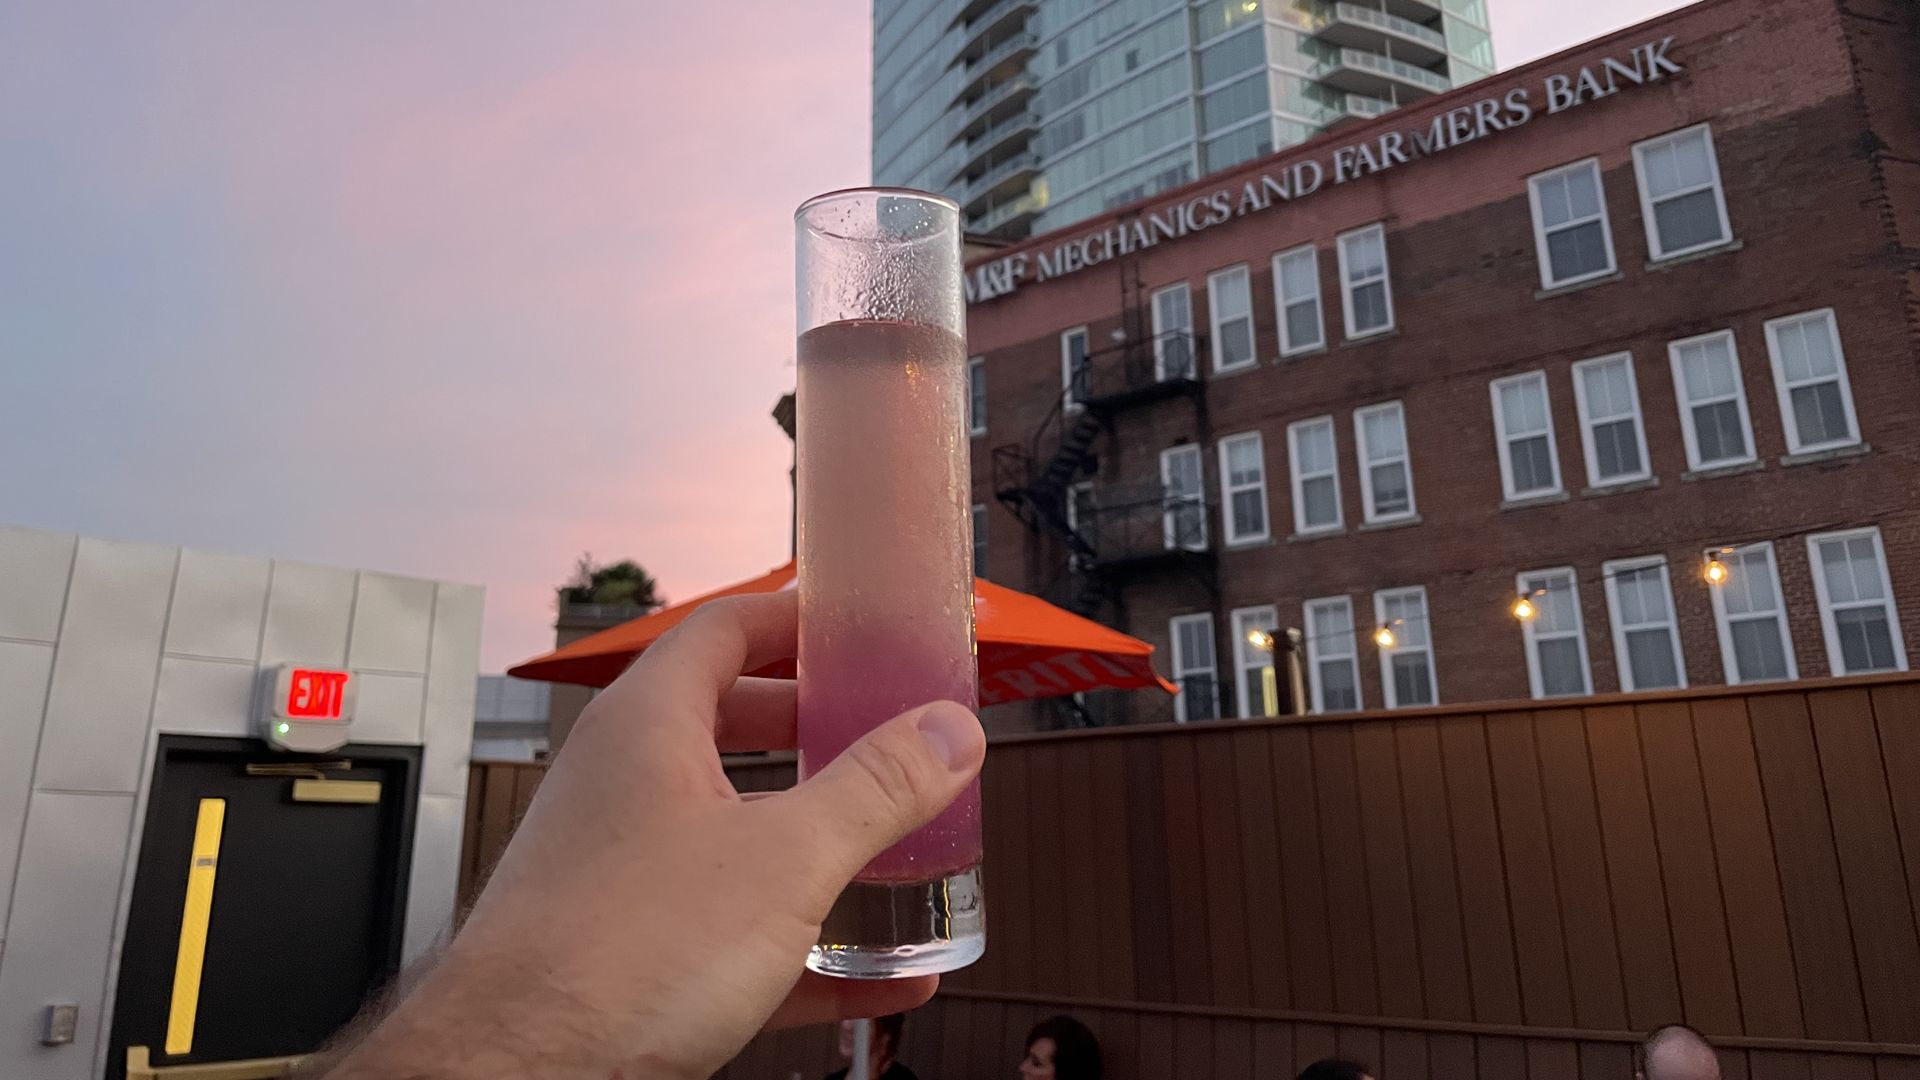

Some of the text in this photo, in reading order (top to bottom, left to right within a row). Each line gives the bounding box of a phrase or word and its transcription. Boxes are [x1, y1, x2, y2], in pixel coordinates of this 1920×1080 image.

[964, 34, 1683, 305] M&F MECHANICS AND FARMERS BANK
[287, 668, 350, 719] EXIT
